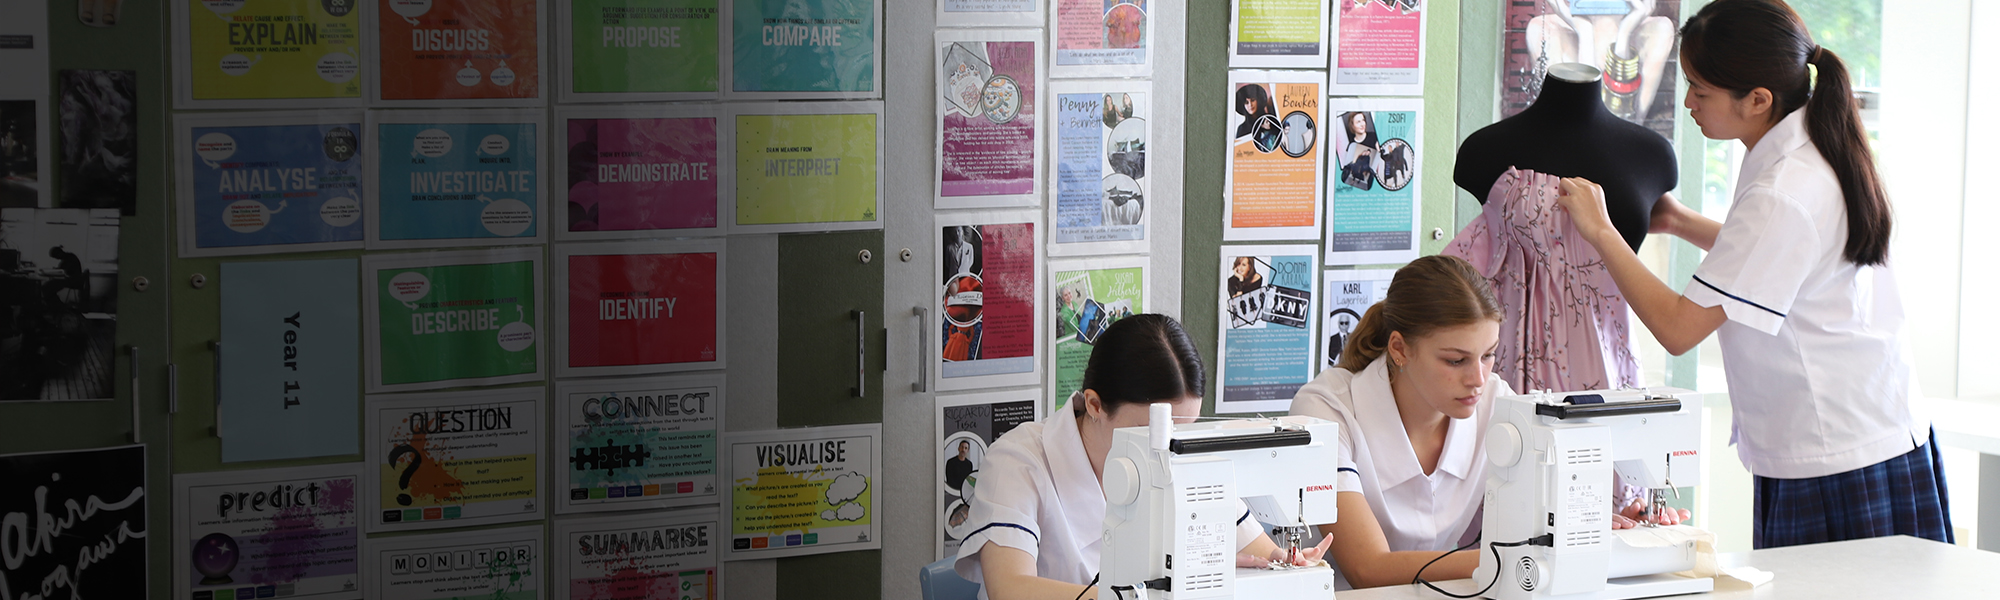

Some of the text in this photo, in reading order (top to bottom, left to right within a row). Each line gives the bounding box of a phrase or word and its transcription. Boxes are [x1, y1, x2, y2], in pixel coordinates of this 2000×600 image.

[229, 23, 317, 45] EXPLAIN
[413, 29, 489, 51] DISCUSS
[603, 27, 681, 47] PROPOSE
[763, 25, 842, 46] COMPARE
[1059, 97, 1099, 118] Penny
[1283, 96, 1317, 109] Bowker
[1071, 117, 1102, 128] Bennett
[1388, 113, 1406, 123] ZSOFI
[599, 162, 708, 182] DEMONSTRATE
[765, 158, 841, 177] INTERPRET
[219, 168, 316, 192] ANALYSE
[410, 171, 530, 193] INVESTIGATE
[1115, 272, 1134, 284] SUSAN
[1278, 262, 1306, 274] DONNA
[1343, 283, 1362, 294] KARL
[440, 299, 483, 307] CHARACTERISTICS
[599, 297, 676, 320] IDENTIFY
[1267, 297, 1307, 316] DKNY
[1337, 295, 1368, 308] Lagerfeld
[412, 308, 499, 335] DESCRIBE
[284, 311, 300, 409] Year 11
[582, 392, 710, 420] CONNECT
[945, 405, 990, 420] RICCARDO
[409, 407, 512, 434] QUESTION
[756, 440, 846, 467] VISUALISE
[217, 482, 320, 518] predict
[579, 526, 708, 556] SUMMARISE
[395, 549, 526, 570] MONITOR
